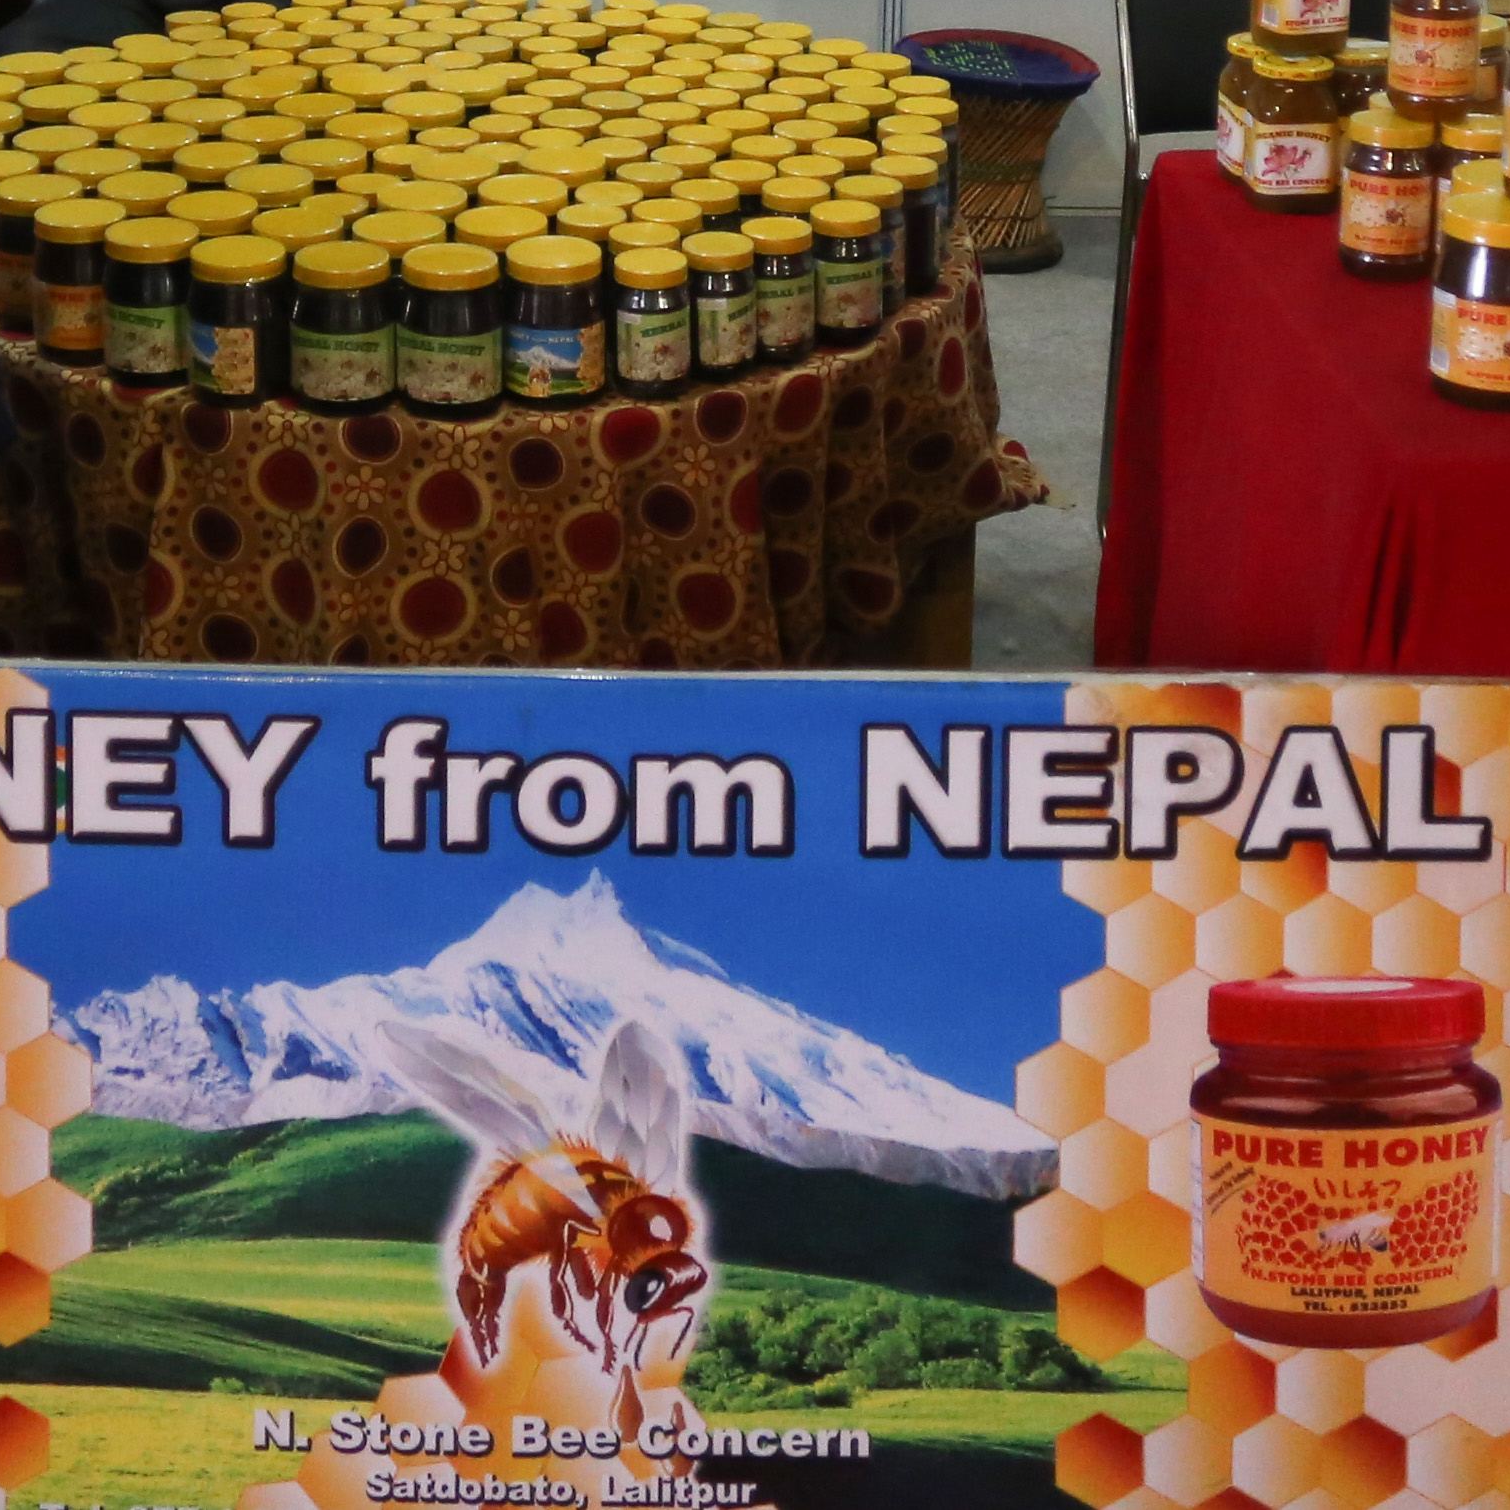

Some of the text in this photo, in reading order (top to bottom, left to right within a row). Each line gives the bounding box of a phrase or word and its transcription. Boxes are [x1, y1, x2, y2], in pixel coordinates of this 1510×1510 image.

[1350, 179, 1388, 196] PURE
[1458, 307, 1507, 325] PURE
[367, 717, 795, 859] from
[859, 723, 1493, 862] NEPAL
[1213, 1125, 1489, 1169] PURE HONEY
[1333, 1274, 1366, 1286] BEE
[1373, 1266, 1453, 1285] CONCERN
[1374, 1285, 1421, 1297] NEPAL
[254, 1409, 871, 1458] N. Stone Bee Concern
[366, 1470, 757, 1510] Satdobato, Lalitpur
